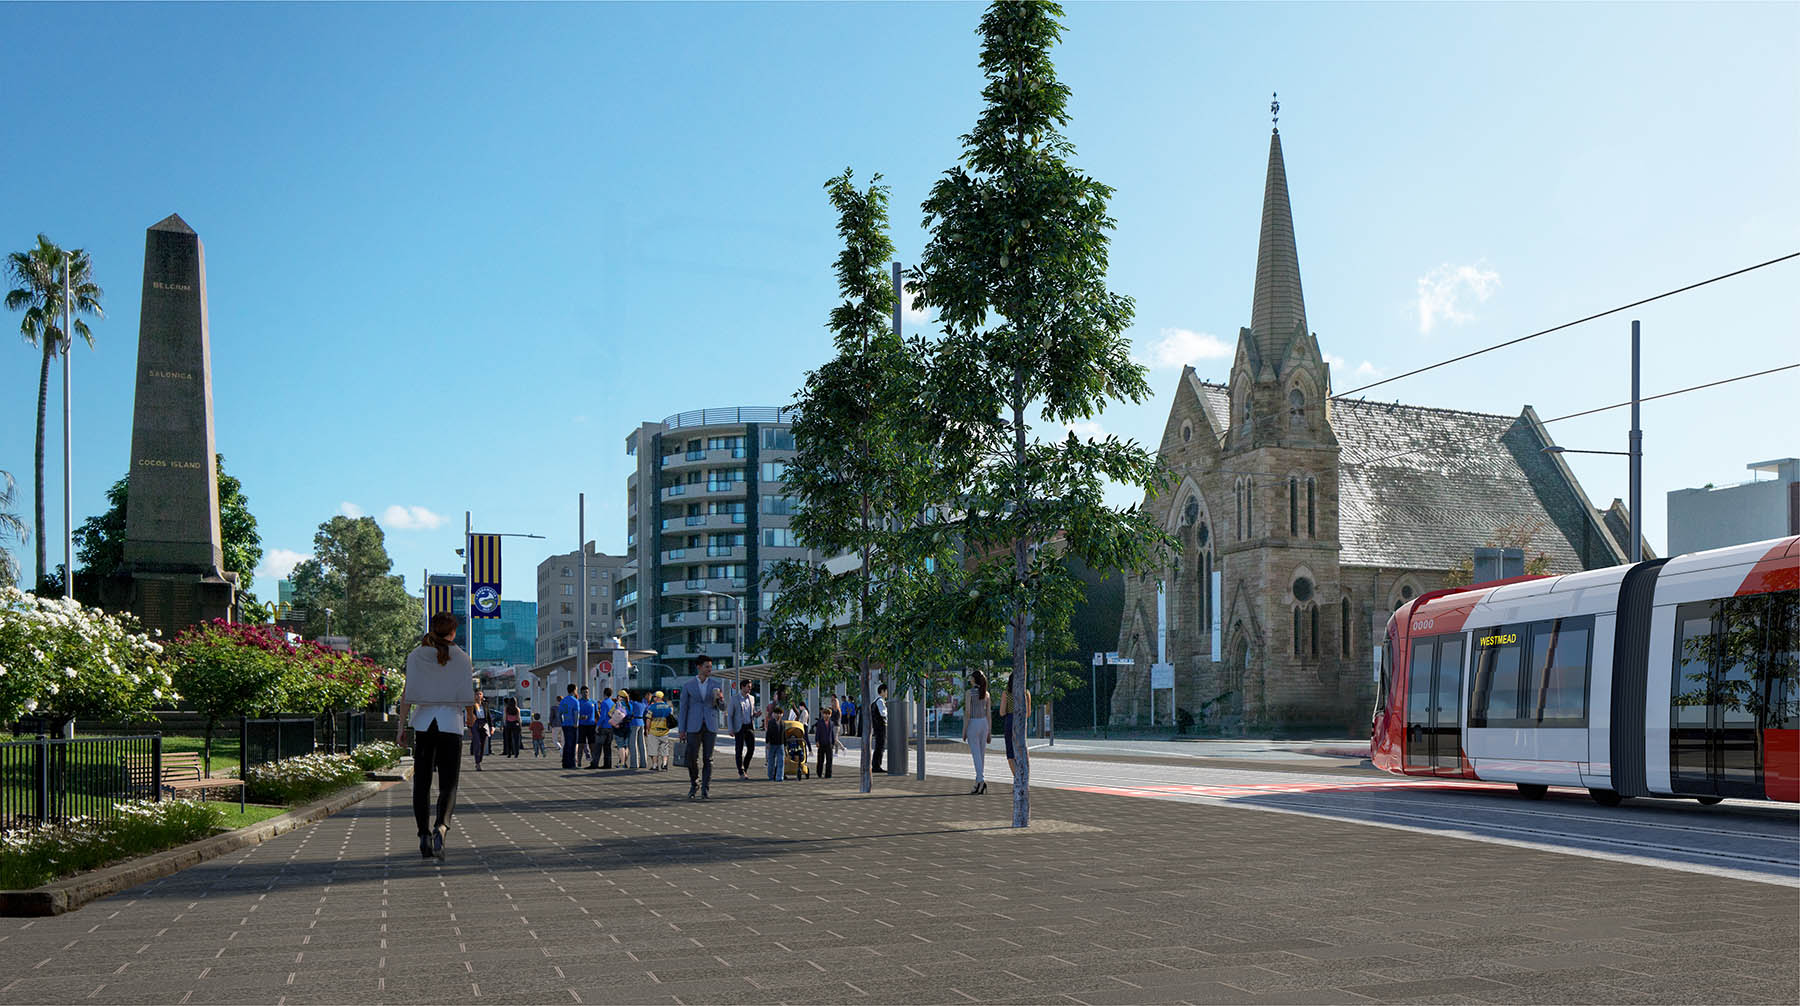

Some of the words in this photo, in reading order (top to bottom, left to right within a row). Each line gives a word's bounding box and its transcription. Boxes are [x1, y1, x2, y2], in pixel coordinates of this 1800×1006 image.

[149, 370, 192, 380] SALONICA
[139, 459, 167, 467] COCOS
[171, 461, 201, 469] ISLAND
[1480, 633, 1518, 647] WESTMEAD
